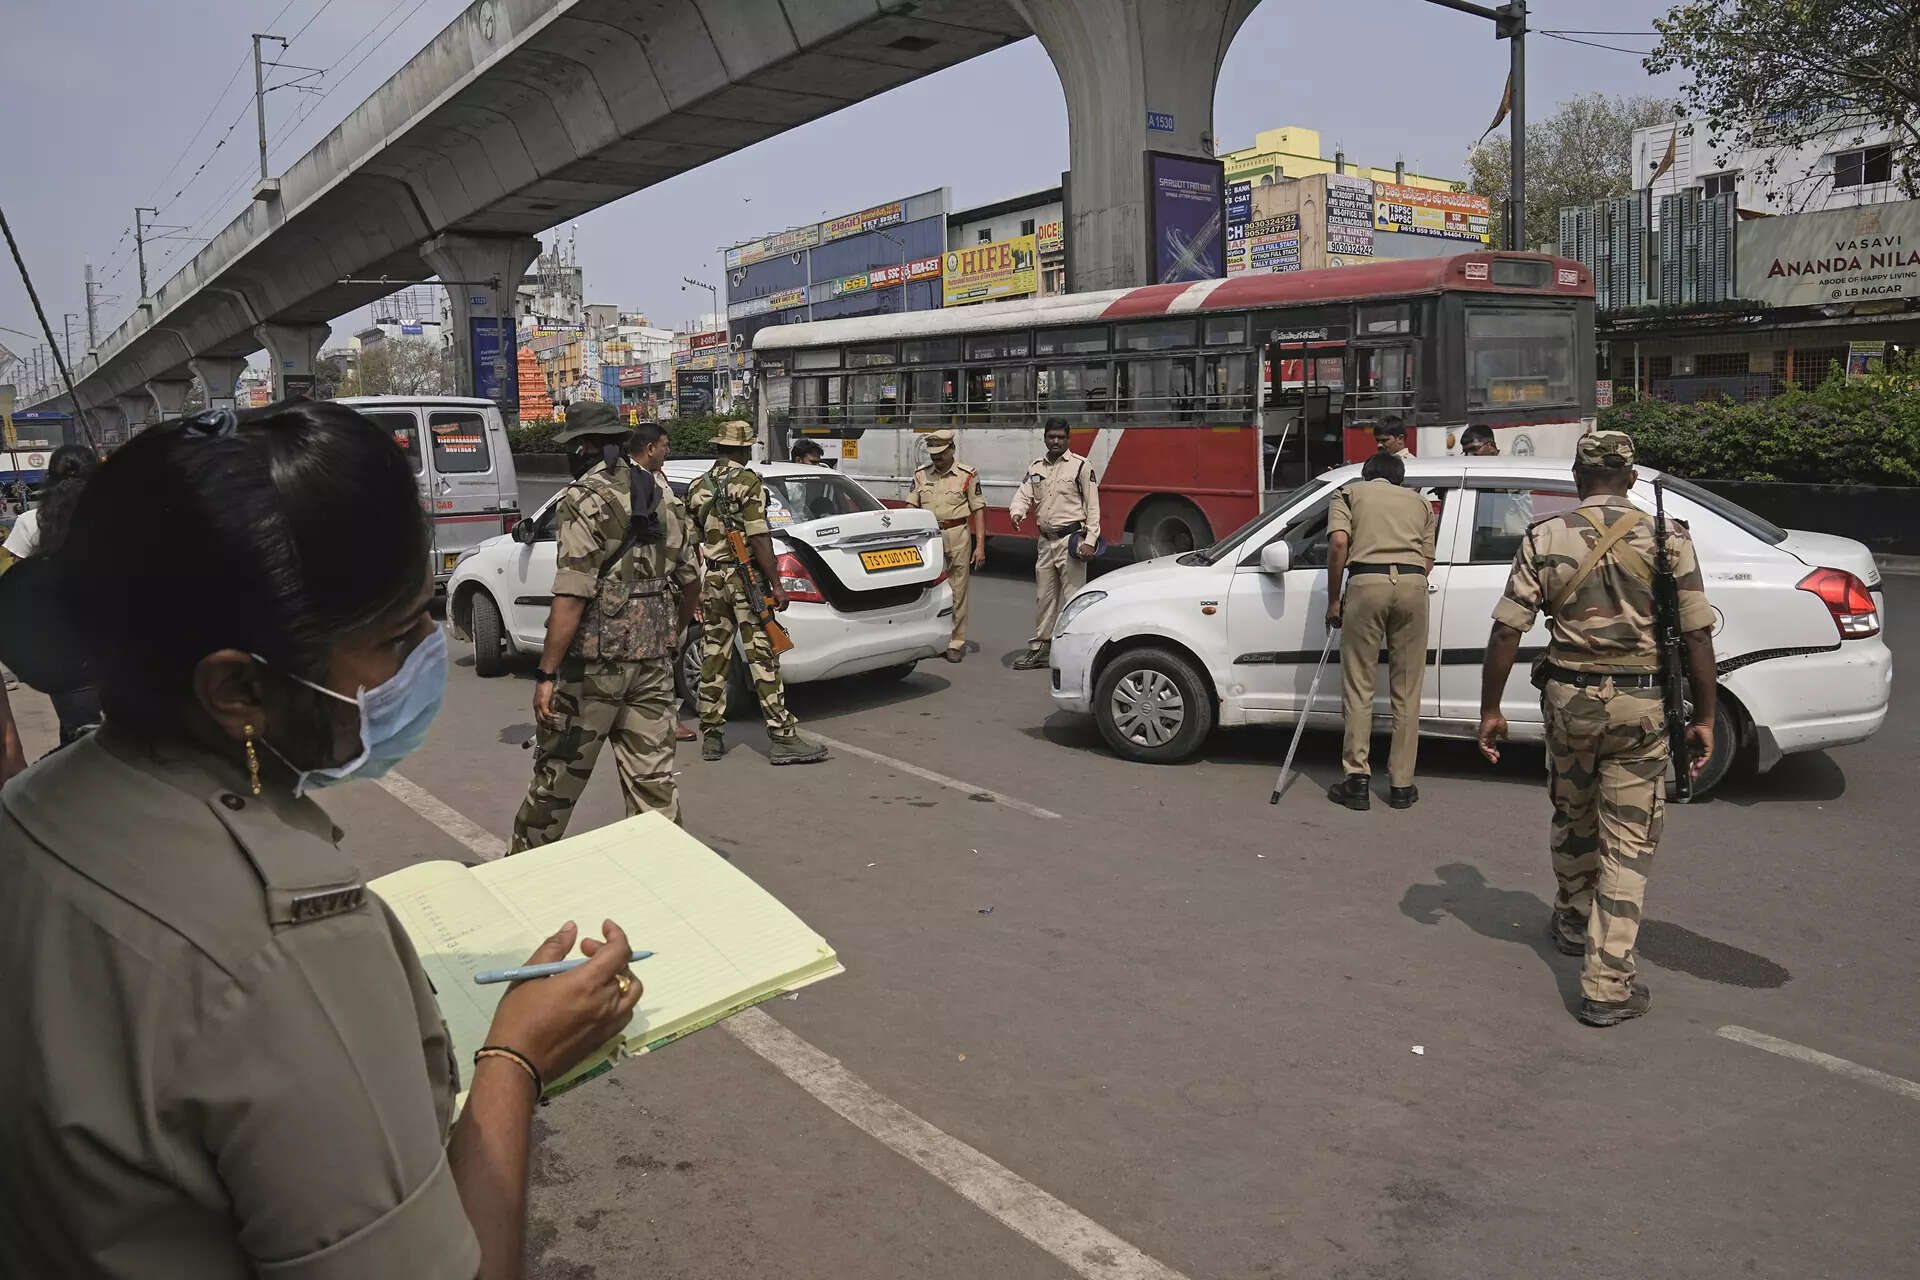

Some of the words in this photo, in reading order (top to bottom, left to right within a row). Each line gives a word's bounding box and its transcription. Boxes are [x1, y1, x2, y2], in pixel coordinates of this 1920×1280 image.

[1148, 115, 1155, 127] A
[1156, 116, 1173, 129] 1530
[1234, 185, 1250, 193] BANK
[1235, 194, 1250, 203] CSAT
[1390, 205, 1412, 215] TSPSC
[1244, 215, 1296, 230] 9030324242
[1389, 214, 1412, 224] APPSC
[1039, 223, 1057, 240] DICE
[1244, 223, 1296, 238] 9052747127
[1470, 225, 1487, 234] FOREST
[1252, 246, 1265, 254] JAVA
[1280, 240, 1297, 248] STACK
[1331, 242, 1374, 256] 9030324242
[1836, 236, 1902, 251] VASAVI
[1252, 253, 1270, 261] PYTHON
[1270, 250, 1282, 258] FULL
[1282, 248, 1298, 256] STACK
[1253, 260, 1269, 268] TALLY
[1283, 264, 1300, 272] FLOOR
[1767, 256, 1862, 278] ANANDA
[1819, 277, 1847, 286] ABODE
[1848, 276, 1859, 284] OF
[1860, 274, 1888, 283] HAPPY
[1890, 271, 1918, 280] LIVING
[1831, 289, 1842, 299] @
[1845, 287, 1859, 297] LB
[1861, 284, 1902, 296] NAGAR
[436, 501, 453, 509] CAB
[868, 550, 920, 568] TS11UD1172
